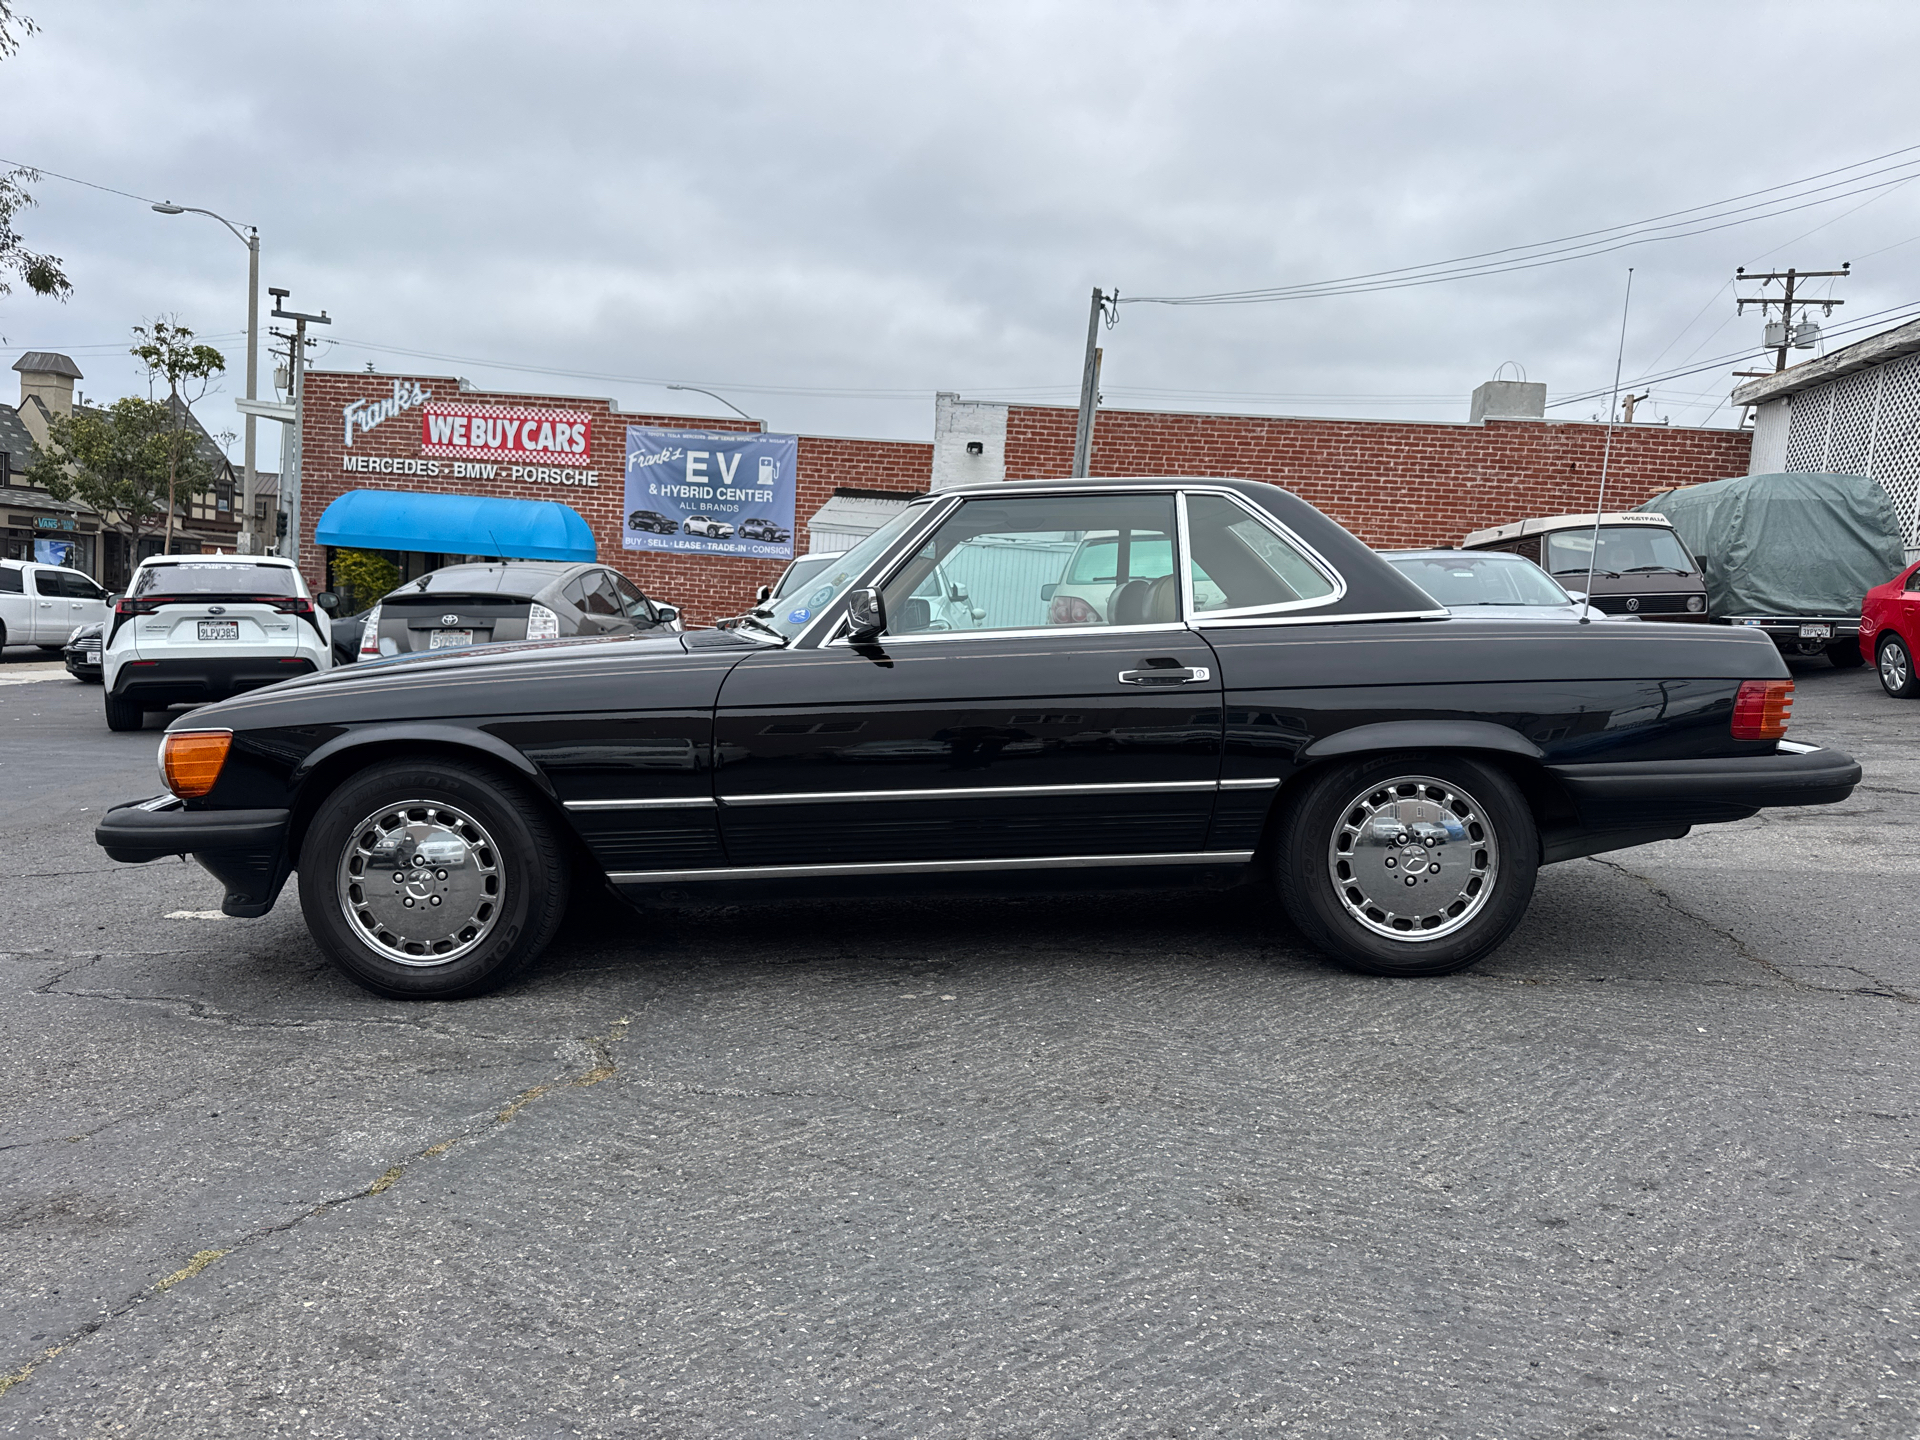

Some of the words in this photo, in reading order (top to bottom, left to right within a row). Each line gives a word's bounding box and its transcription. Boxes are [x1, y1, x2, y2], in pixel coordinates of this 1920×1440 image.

[342, 378, 432, 448] Frank's
[428, 414, 468, 446] WE
[470, 417, 521, 449] BUY
[521, 420, 587, 454] CARS
[343, 455, 440, 476] MERCEDES
[454, 463, 498, 480] BMW
[512, 466, 600, 487] PORSCHE
[628, 447, 685, 473] Frank's
[686, 450, 743, 485] EV
[648, 483, 658, 495] &
[660, 485, 713, 499] HYBRID
[716, 488, 773, 503] CENTER
[679, 501, 697, 510] ALL
[700, 503, 740, 513] BRANDS
[38, 517, 58, 529] VANS
[625, 537, 642, 546] BUY
[647, 539, 668, 548] SELL
[674, 541, 701, 550] LEASE
[707, 543, 747, 552] TRADE-IN
[752, 545, 791, 555] CONSIGN
[200, 627, 236, 638] 9LPV385
